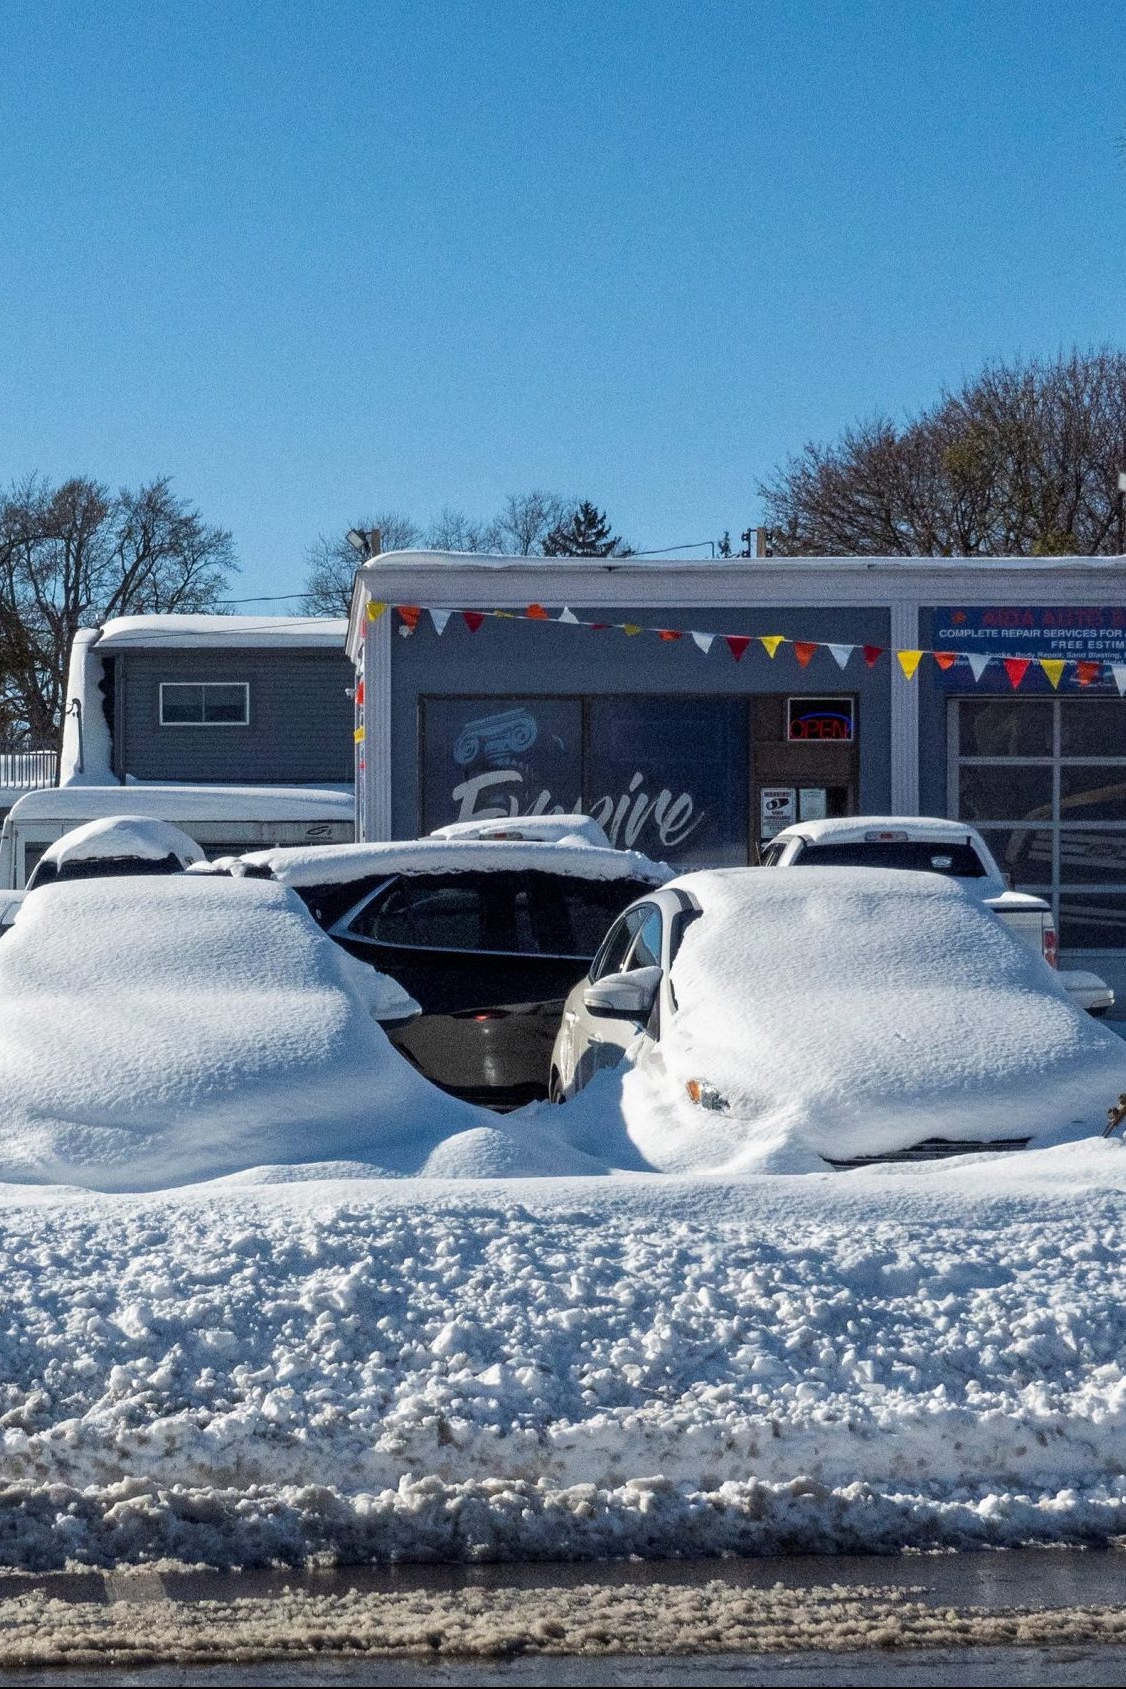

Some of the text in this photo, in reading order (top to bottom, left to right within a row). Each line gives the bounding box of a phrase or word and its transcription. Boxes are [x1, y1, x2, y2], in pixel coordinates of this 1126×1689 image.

[939, 629, 1123, 638] COMPLETE REPAIR SERVICES FOR
[1051, 640, 1125, 649] FREE ESTIM
[1066, 651, 1086, 659] Sand
[1088, 651, 1122, 660] Blasting,
[790, 719, 848, 739] OPEN
